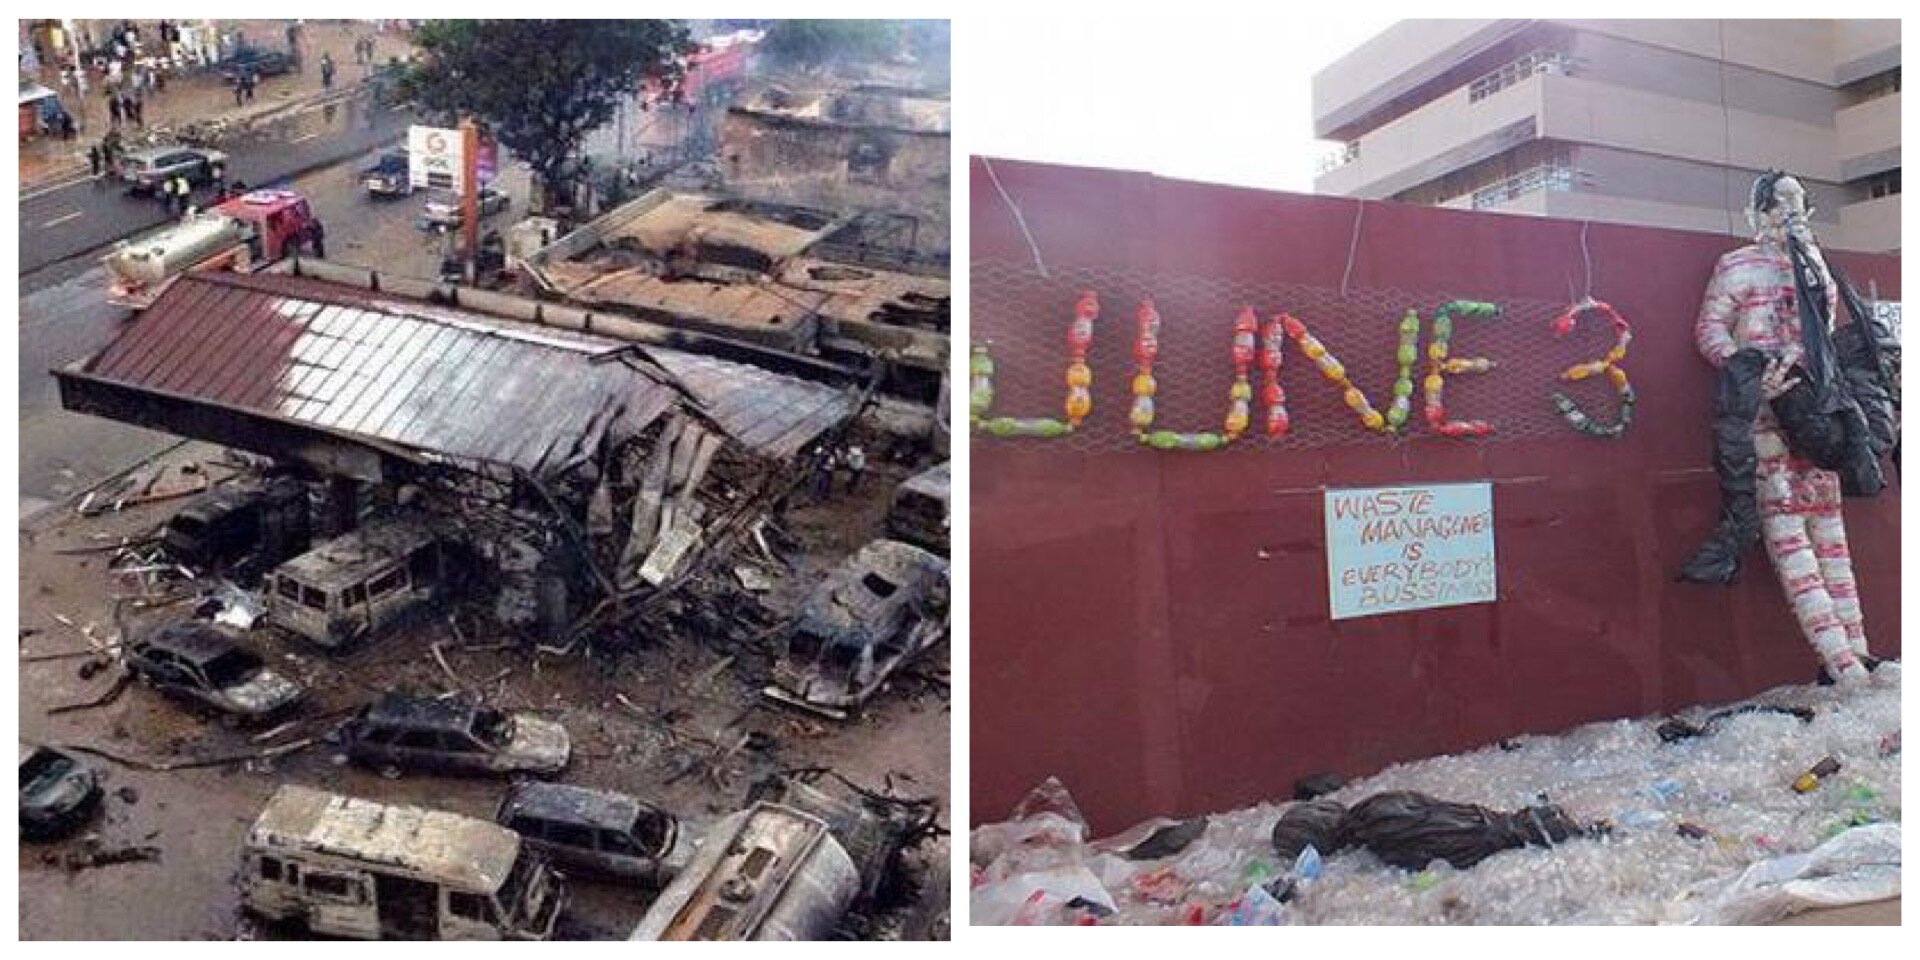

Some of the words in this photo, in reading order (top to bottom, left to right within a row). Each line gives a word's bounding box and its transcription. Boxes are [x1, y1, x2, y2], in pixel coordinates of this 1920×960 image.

[970, 290, 1500, 450] JUNE
[1551, 297, 1635, 438] 3
[1334, 490, 1434, 520] WASTE
[1401, 541, 1424, 561] IS
